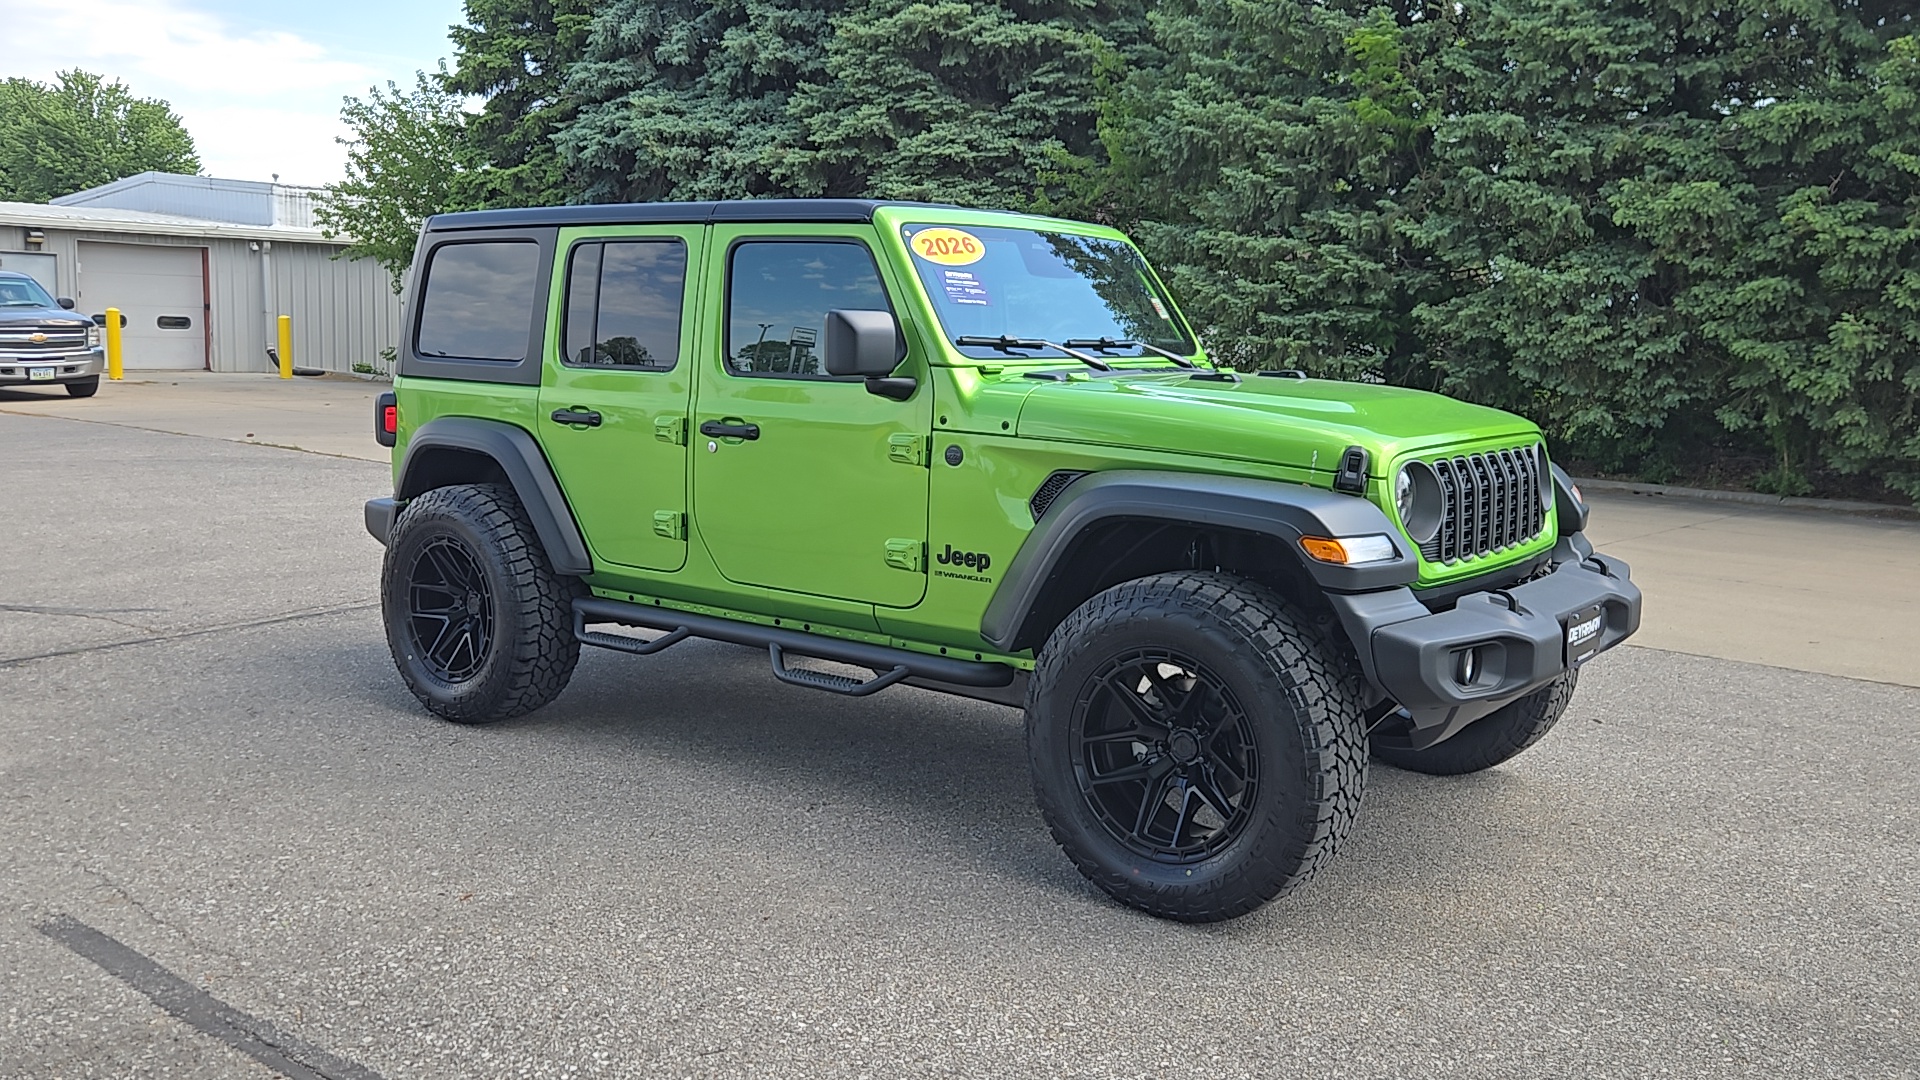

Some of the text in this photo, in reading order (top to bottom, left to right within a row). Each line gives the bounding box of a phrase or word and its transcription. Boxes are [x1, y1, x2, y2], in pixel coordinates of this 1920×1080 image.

[921, 236, 977, 257] 2026
[936, 543, 991, 573] Jeep
[942, 571, 992, 584] WRANGLER
